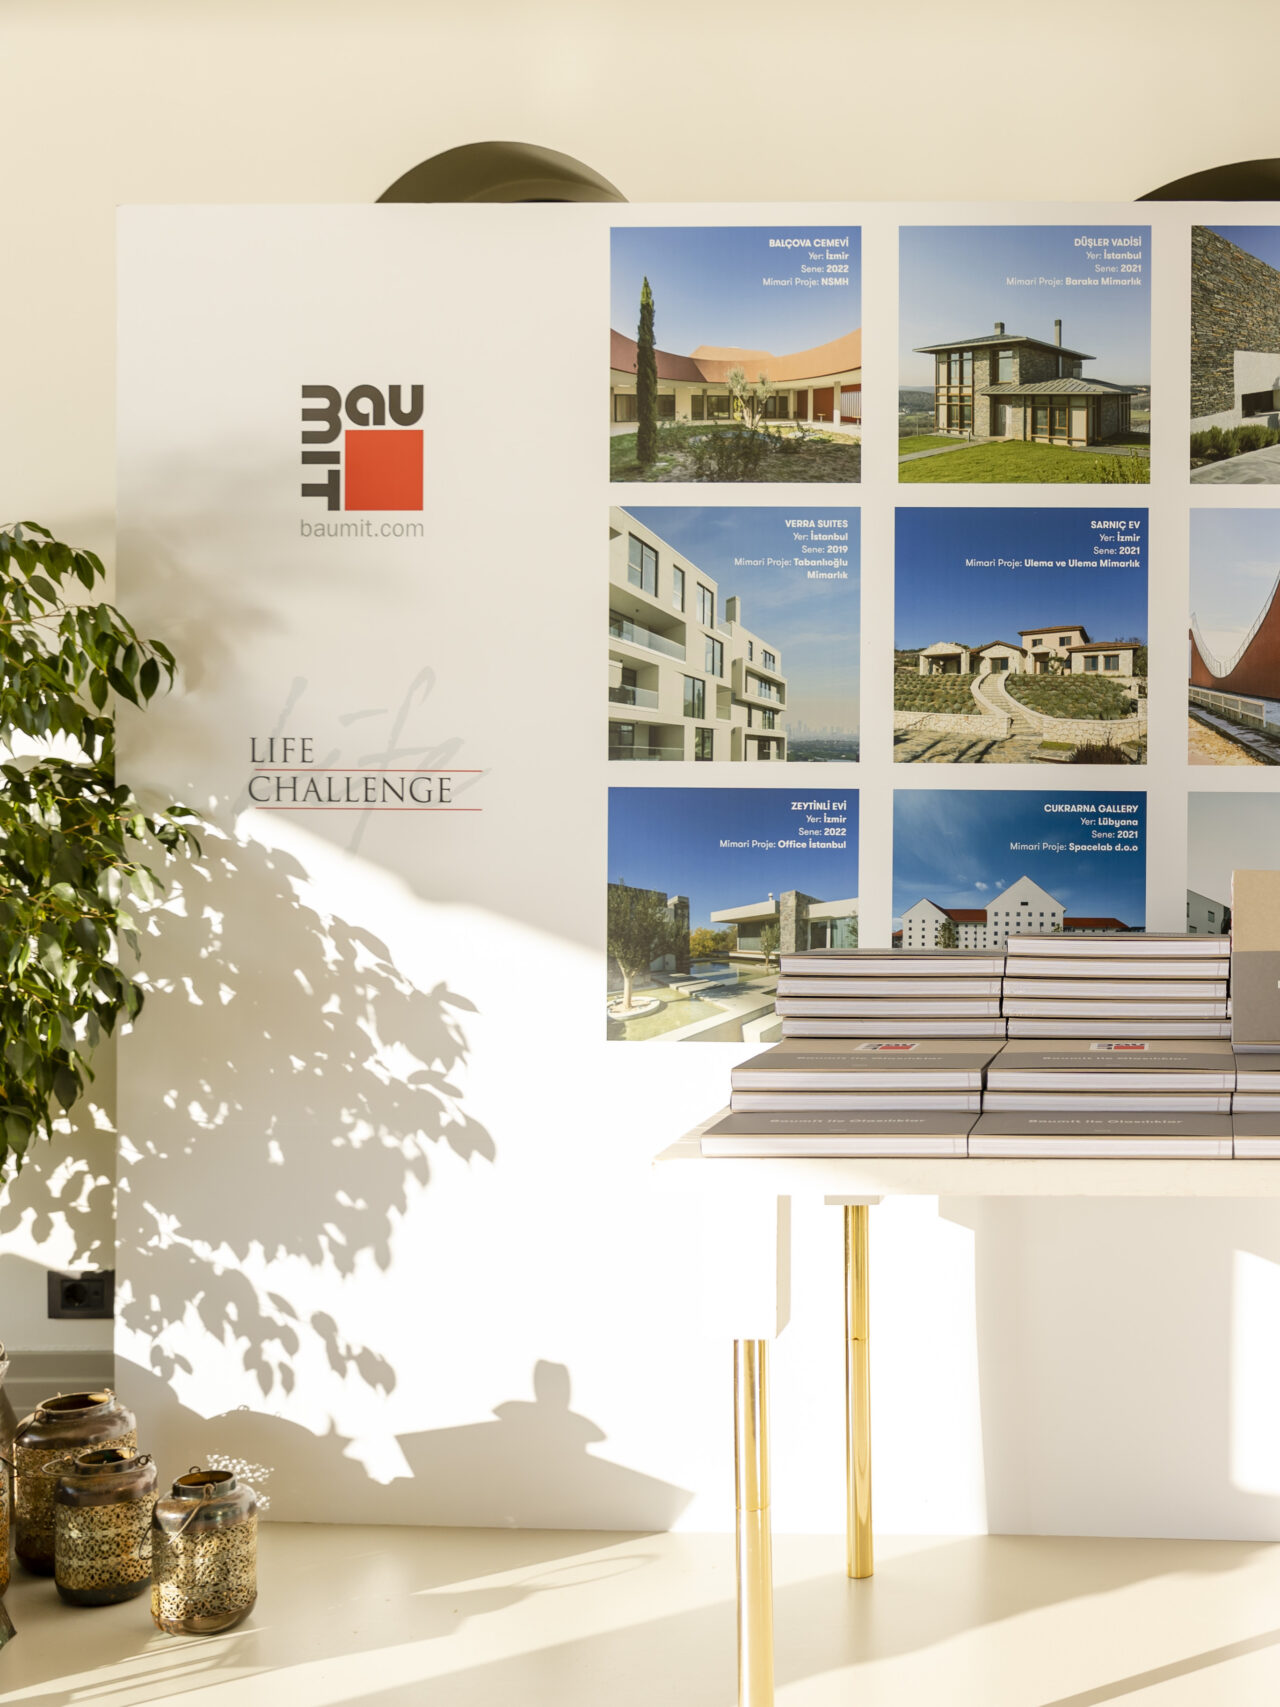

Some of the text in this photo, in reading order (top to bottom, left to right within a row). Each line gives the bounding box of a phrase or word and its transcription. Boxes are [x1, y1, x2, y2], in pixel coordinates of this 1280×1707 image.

[769, 239, 811, 249] BALÇOVA
[1074, 236, 1109, 248] DÜŞLER
[301, 519, 424, 537] baumit.com
[1091, 521, 1126, 530] SARNIÇ
[966, 559, 995, 567] Mimari
[998, 559, 1022, 569] Proje:
[1025, 559, 1053, 567] Ulema
[1068, 559, 1097, 567] Ulema
[250, 737, 314, 763] LIFE
[248, 775, 452, 804] CHALLENGE
[1044, 804, 1096, 812] CUKRARNA
[806, 815, 821, 823] Yer:
[1098, 818, 1138, 827] Lübyana
[1092, 830, 1115, 838] Sene:
[752, 840, 775, 850] Proje:
[778, 840, 807, 848] Office
[1010, 843, 1040, 851] Mimari
[1043, 843, 1066, 853] Proje:
[1069, 843, 1112, 852] Spacelab
